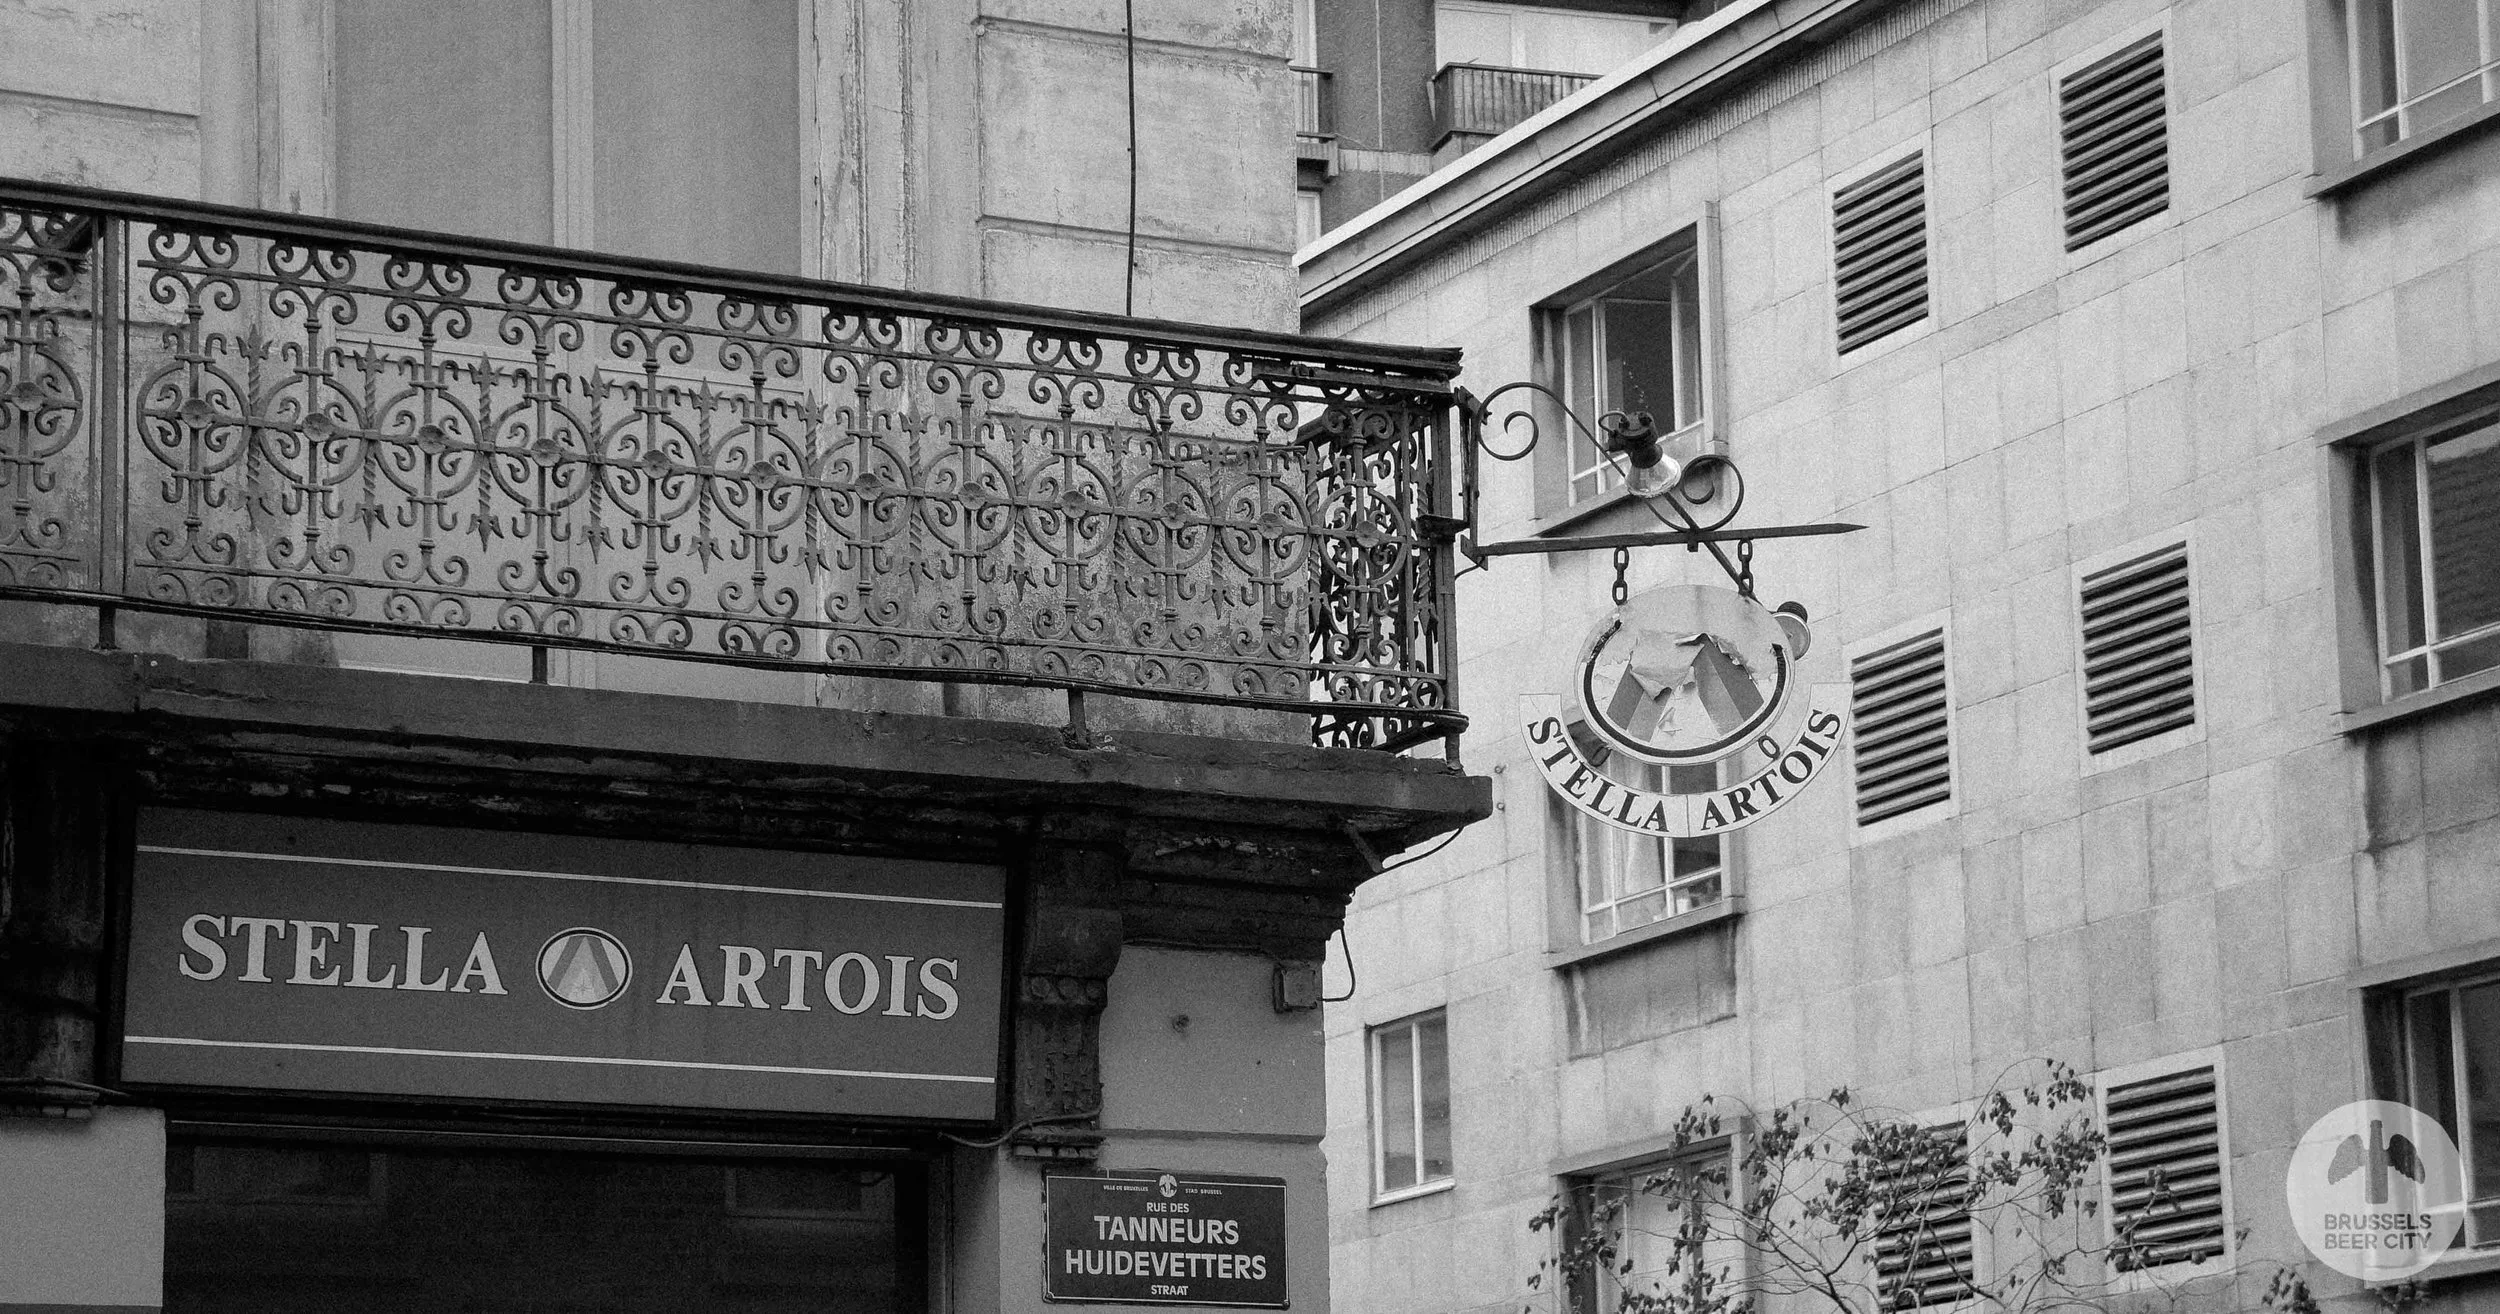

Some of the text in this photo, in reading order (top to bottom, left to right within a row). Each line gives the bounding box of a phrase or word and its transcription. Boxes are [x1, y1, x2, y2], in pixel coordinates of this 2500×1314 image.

[1528, 709, 1841, 832] STELLA ARTOIS
[179, 913, 960, 1020] STELLA ARTOIS
[1147, 1202, 1189, 1213] RUE DES
[1094, 1216, 1239, 1245] TANNEURS
[1065, 1249, 1267, 1280] HUIDEVETTERS
[1151, 1285, 1188, 1295] STRAAT
